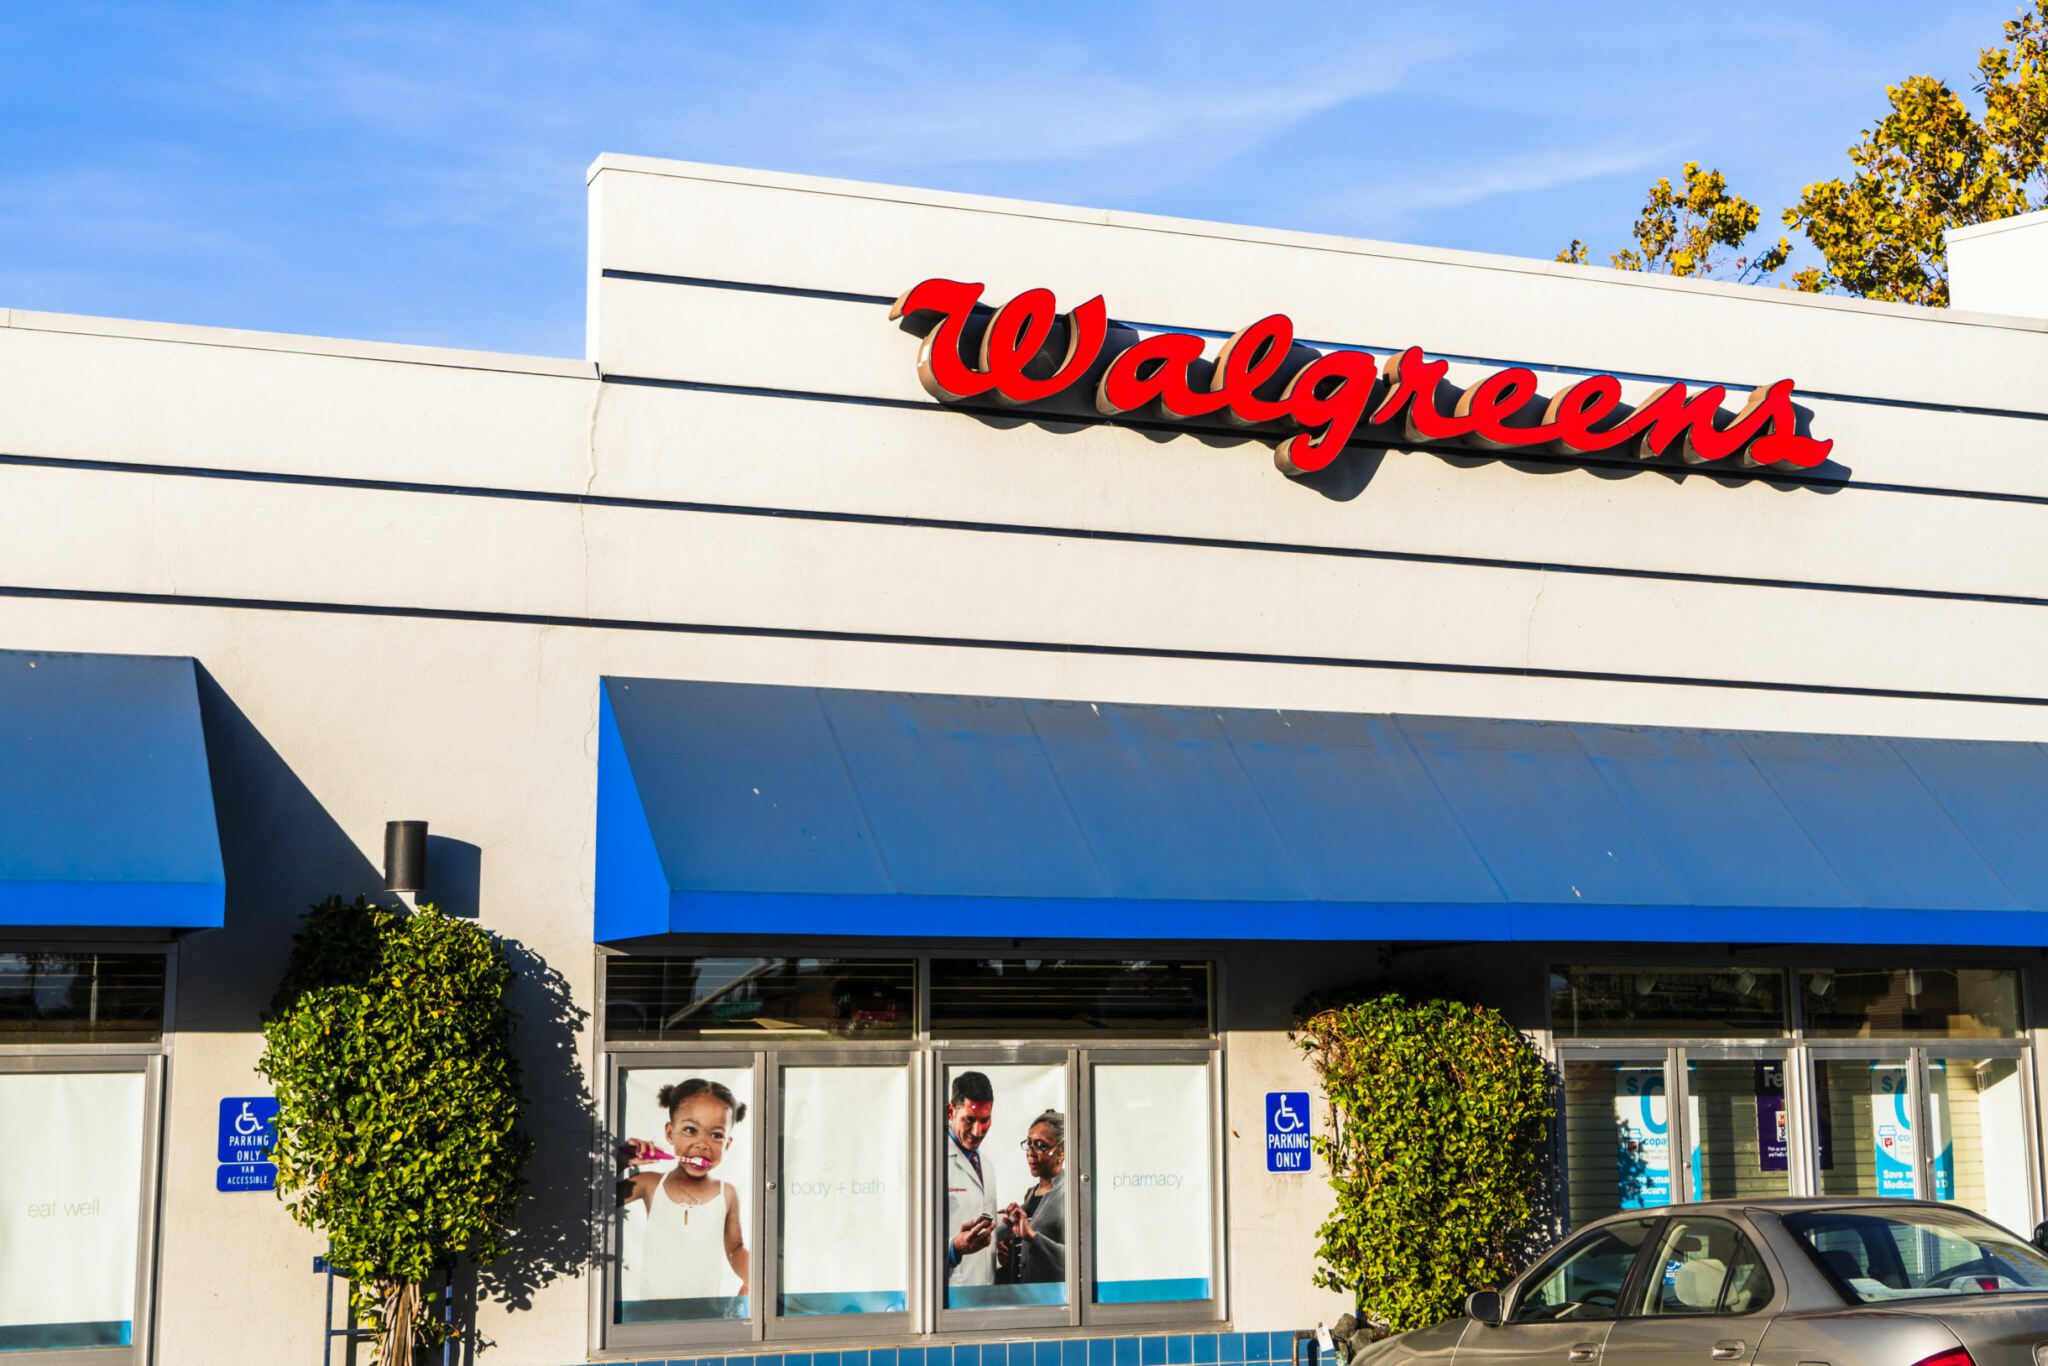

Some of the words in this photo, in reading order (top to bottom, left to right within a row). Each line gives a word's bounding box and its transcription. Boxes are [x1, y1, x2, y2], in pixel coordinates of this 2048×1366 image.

[897, 278, 1834, 472] Walgreens
[229, 1135, 269, 1146] PARKING
[1268, 1133, 1309, 1149] PARKING
[1643, 1137, 1667, 1148] copa
[237, 1150, 261, 1162] ONLY
[1276, 1151, 1302, 1168] ONLY
[241, 1165, 254, 1173] VAN
[1883, 1170, 1904, 1179] Save
[227, 1176, 268, 1185] ACCESSIBLE
[1112, 1170, 1184, 1192] pharmacy
[791, 1179, 831, 1199] body
[851, 1178, 886, 1194] bath
[27, 1200, 57, 1218] eat
[63, 1197, 100, 1217] well
